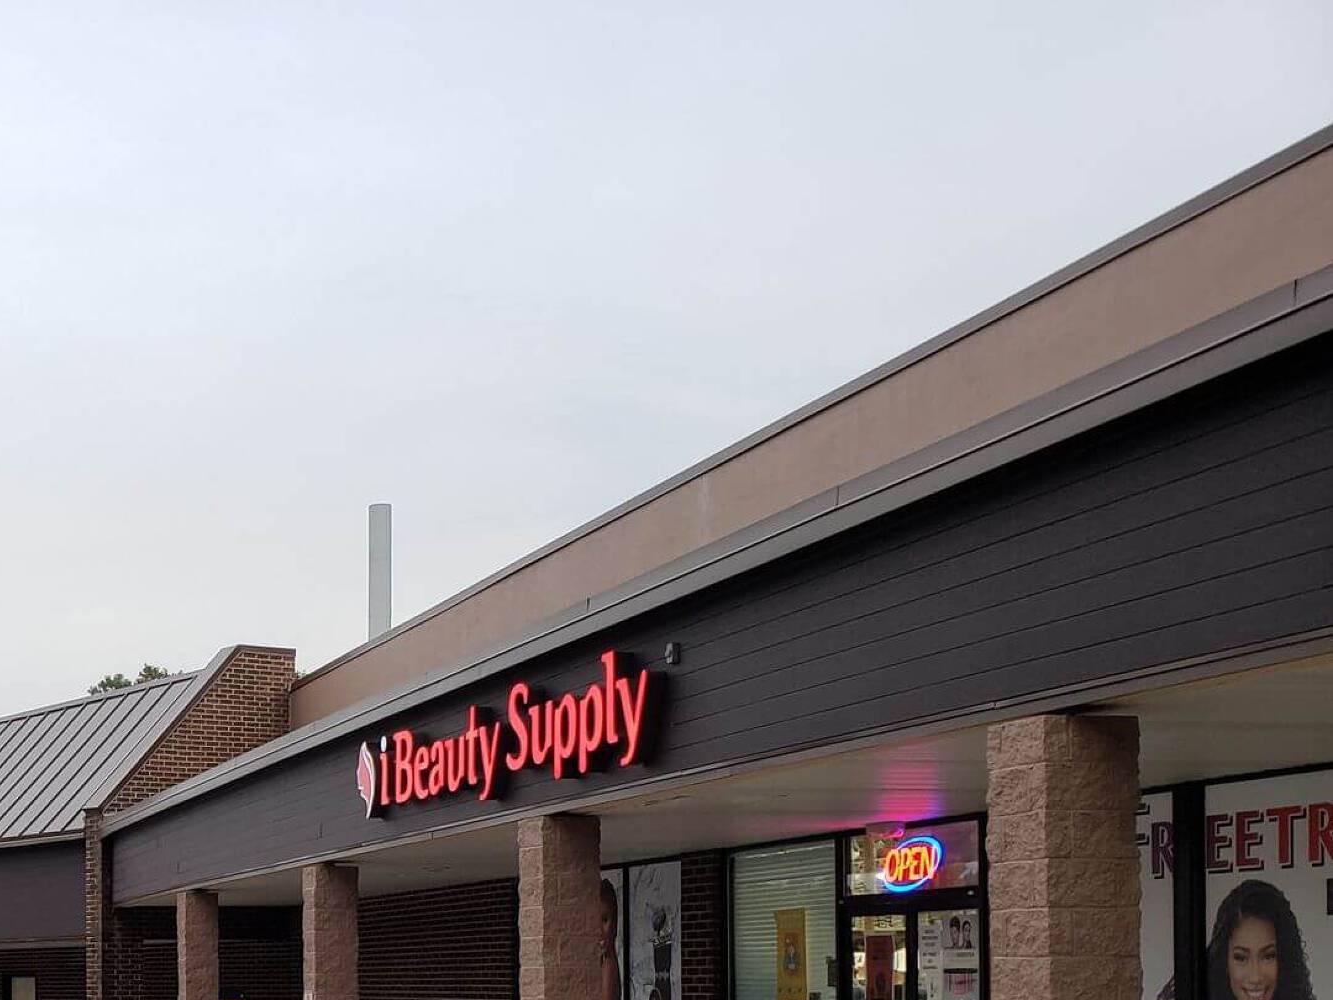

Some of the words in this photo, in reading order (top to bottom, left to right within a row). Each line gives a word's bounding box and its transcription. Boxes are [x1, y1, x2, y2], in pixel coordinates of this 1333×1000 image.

[379, 735, 391, 806] i
[392, 704, 501, 804] Beauty
[505, 650, 649, 781] Supply
[885, 846, 937, 883] OPEN
